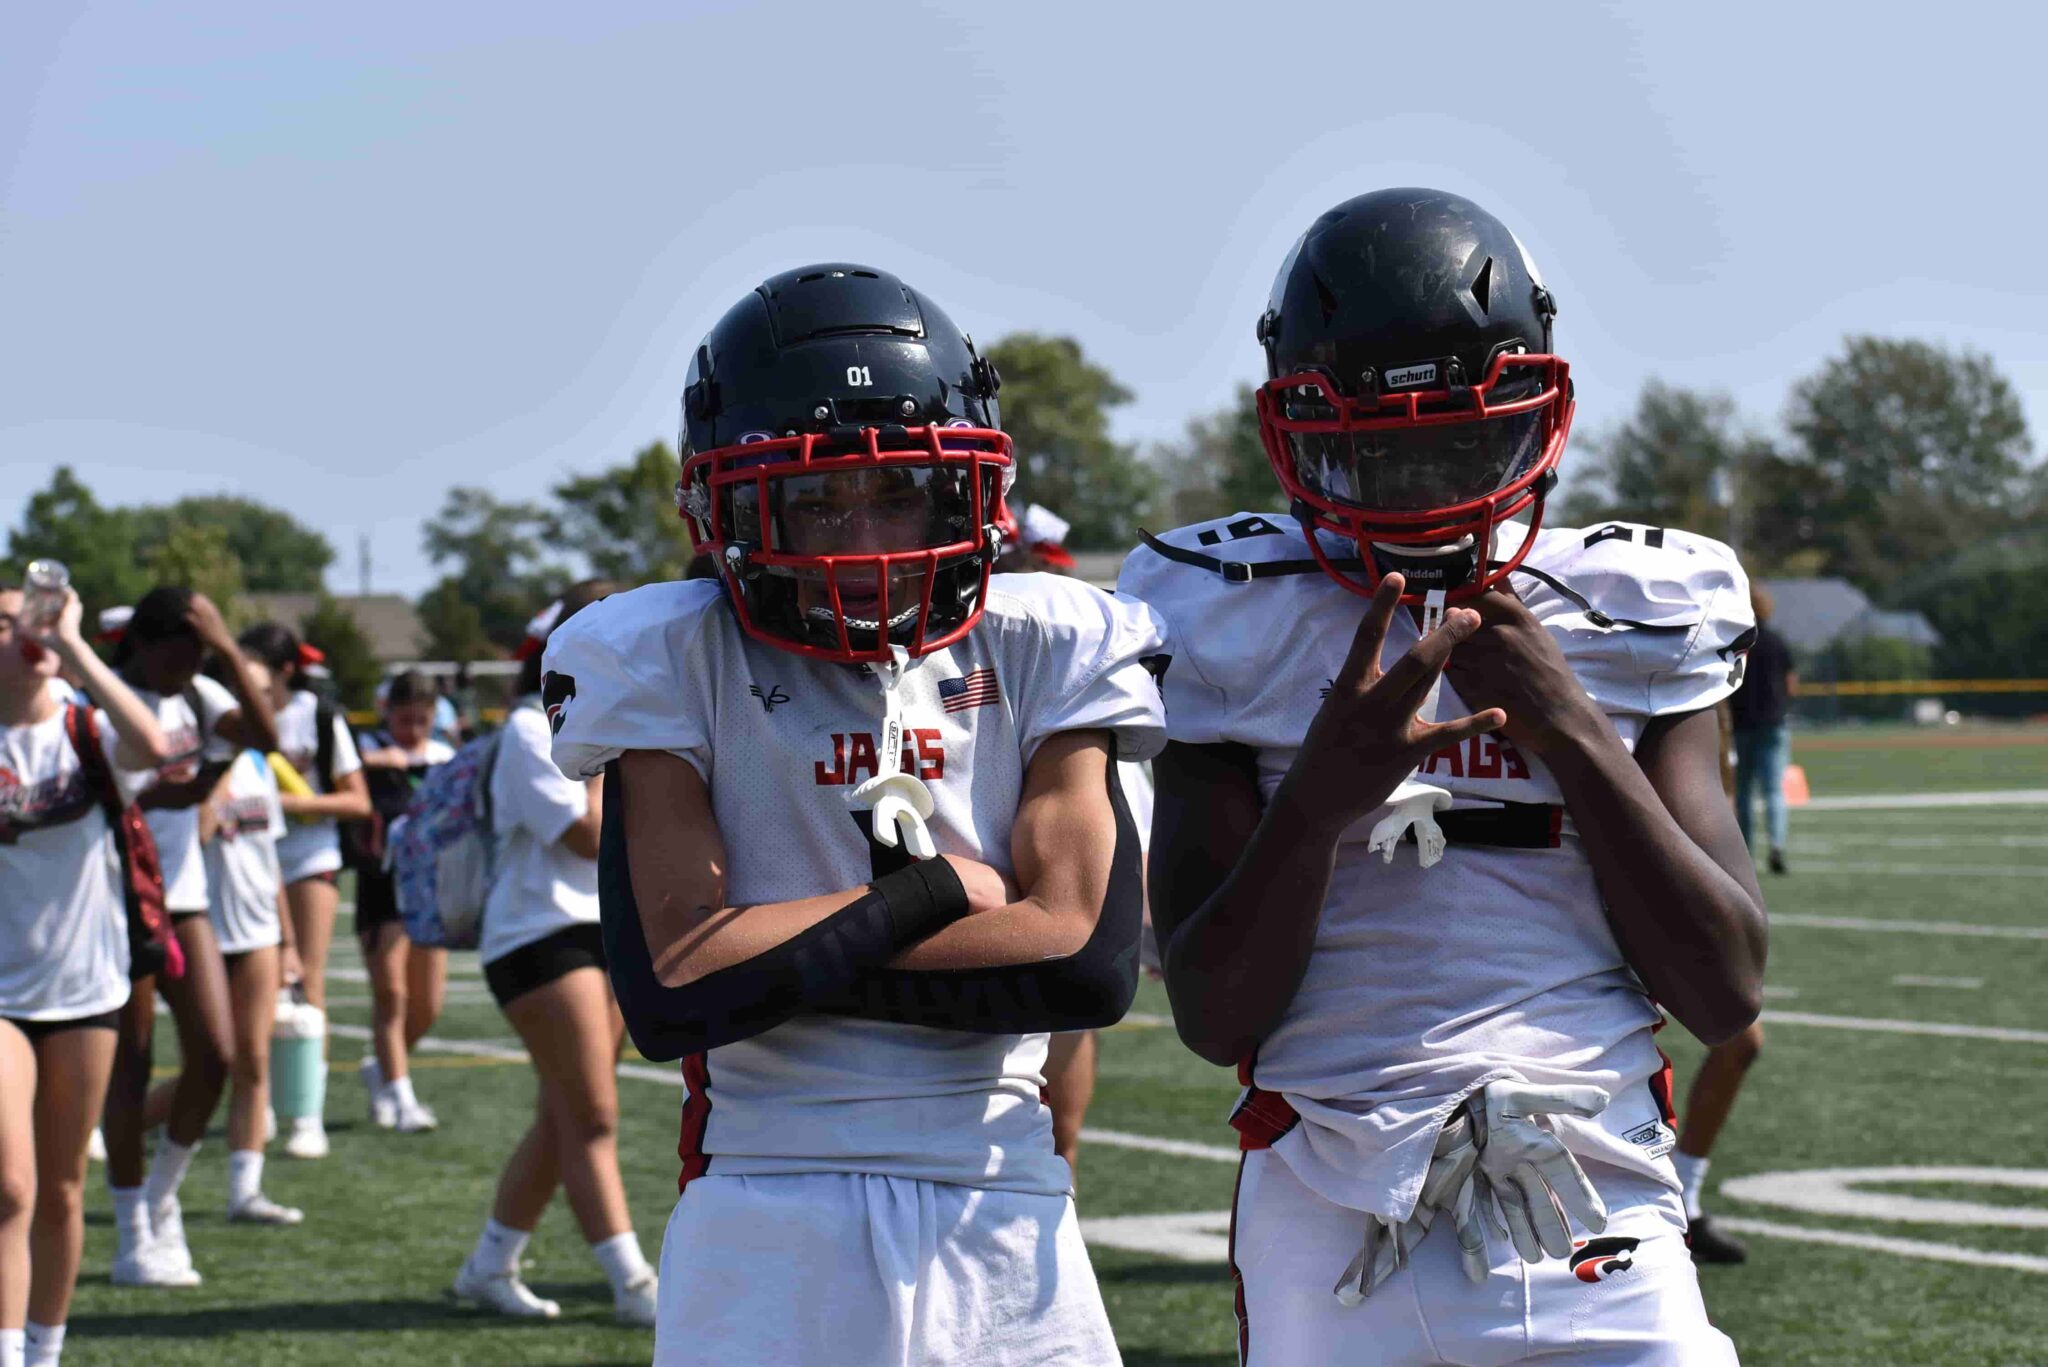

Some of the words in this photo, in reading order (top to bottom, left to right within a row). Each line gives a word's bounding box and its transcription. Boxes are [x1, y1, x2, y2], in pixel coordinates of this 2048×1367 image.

[847, 366, 873, 386] 01
[1390, 369, 1436, 385] schutt
[1401, 568, 1443, 579] Riddell
[1418, 735, 1531, 780] AGS
